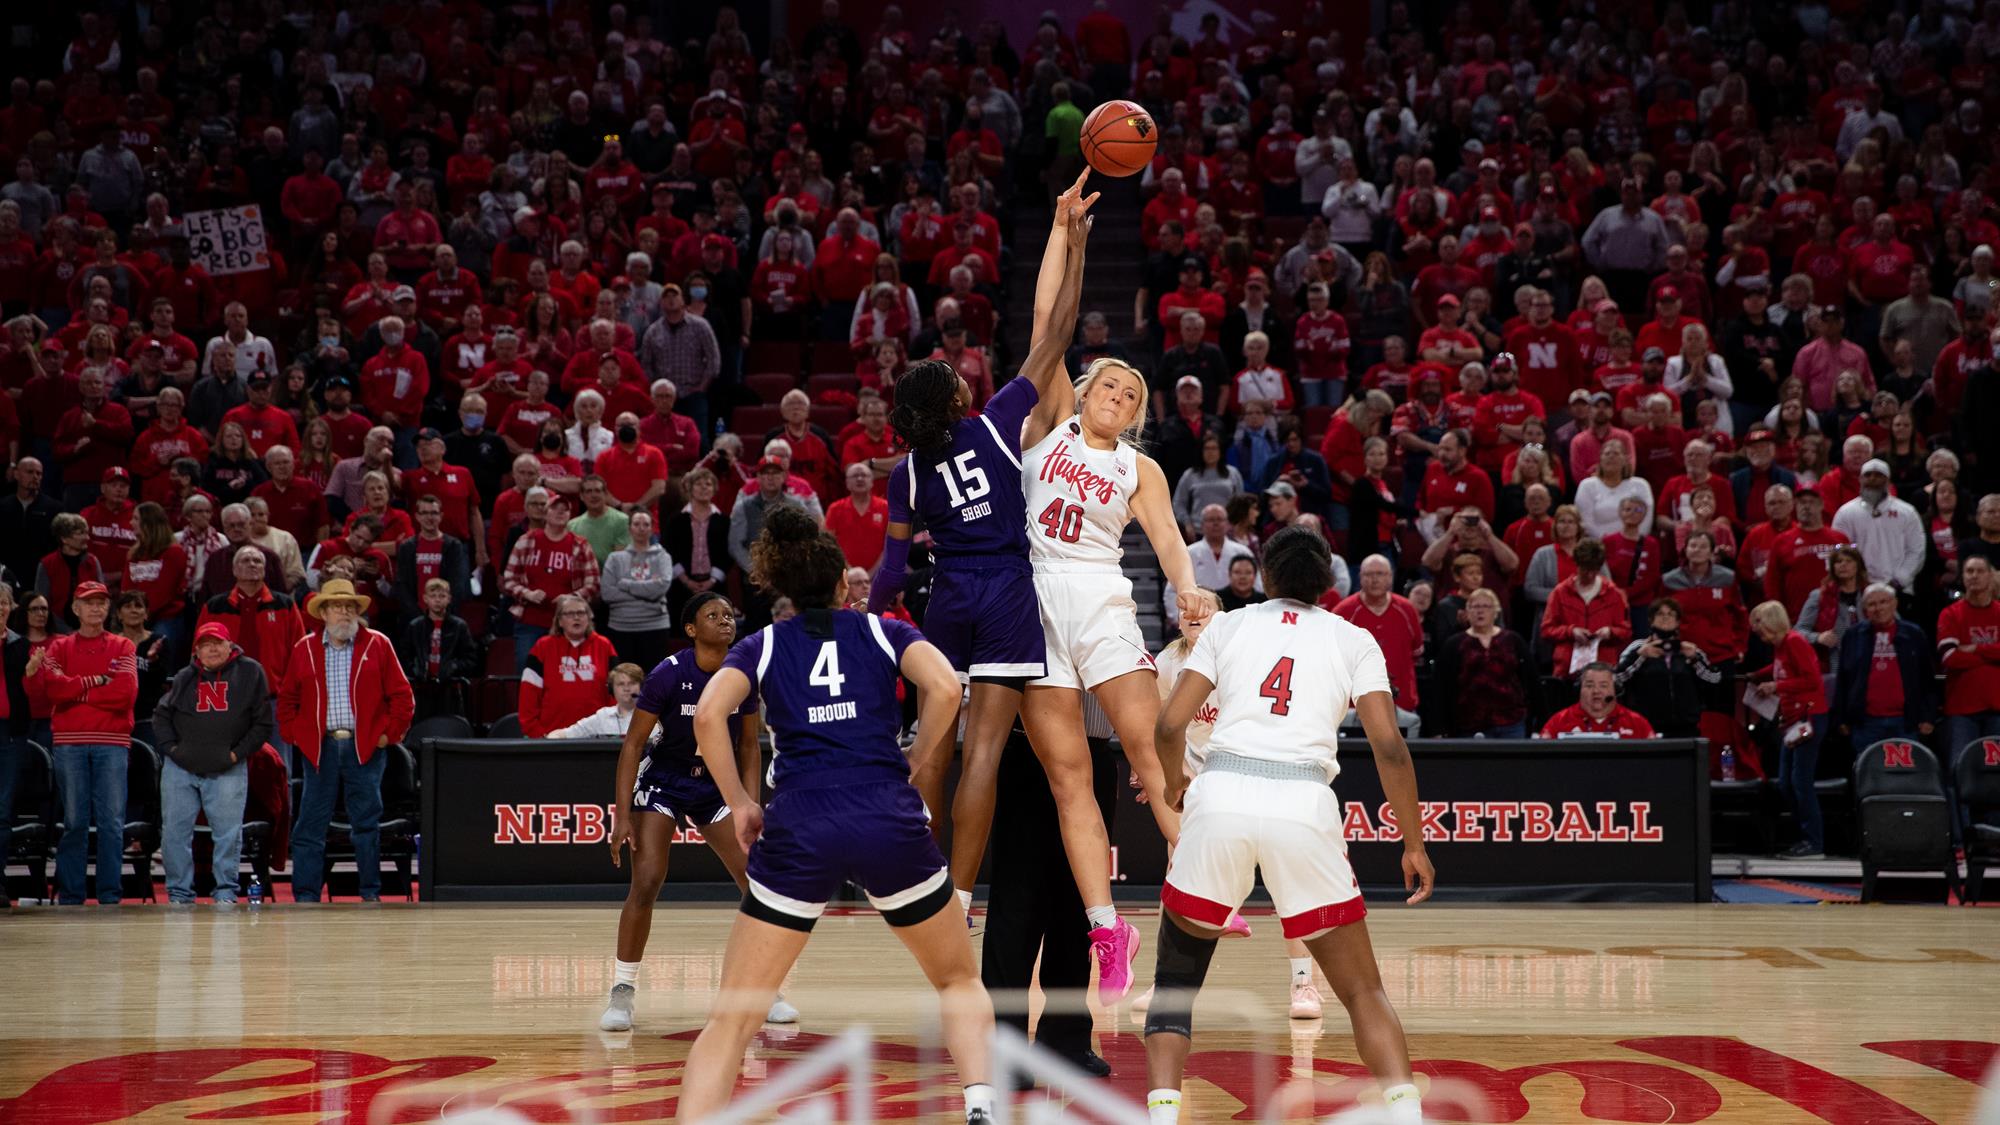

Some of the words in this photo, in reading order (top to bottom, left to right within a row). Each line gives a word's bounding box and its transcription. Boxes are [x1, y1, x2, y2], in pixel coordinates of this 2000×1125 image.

[222, 221, 262, 251] BIG
[209, 250, 252, 272] RED
[457, 342, 486, 368] N
[1527, 342, 1558, 369] N
[935, 449, 991, 508] 15
[1039, 440, 1117, 505] Huskers
[961, 501, 992, 522] SHAW
[1038, 497, 1085, 543] 40
[1281, 611, 1299, 625] N
[809, 640, 846, 697] 4
[196, 680, 229, 712] N
[1259, 655, 1295, 716] 4
[807, 701, 857, 723] BROWN
[1883, 742, 1915, 768] N
[633, 790, 650, 807] N
